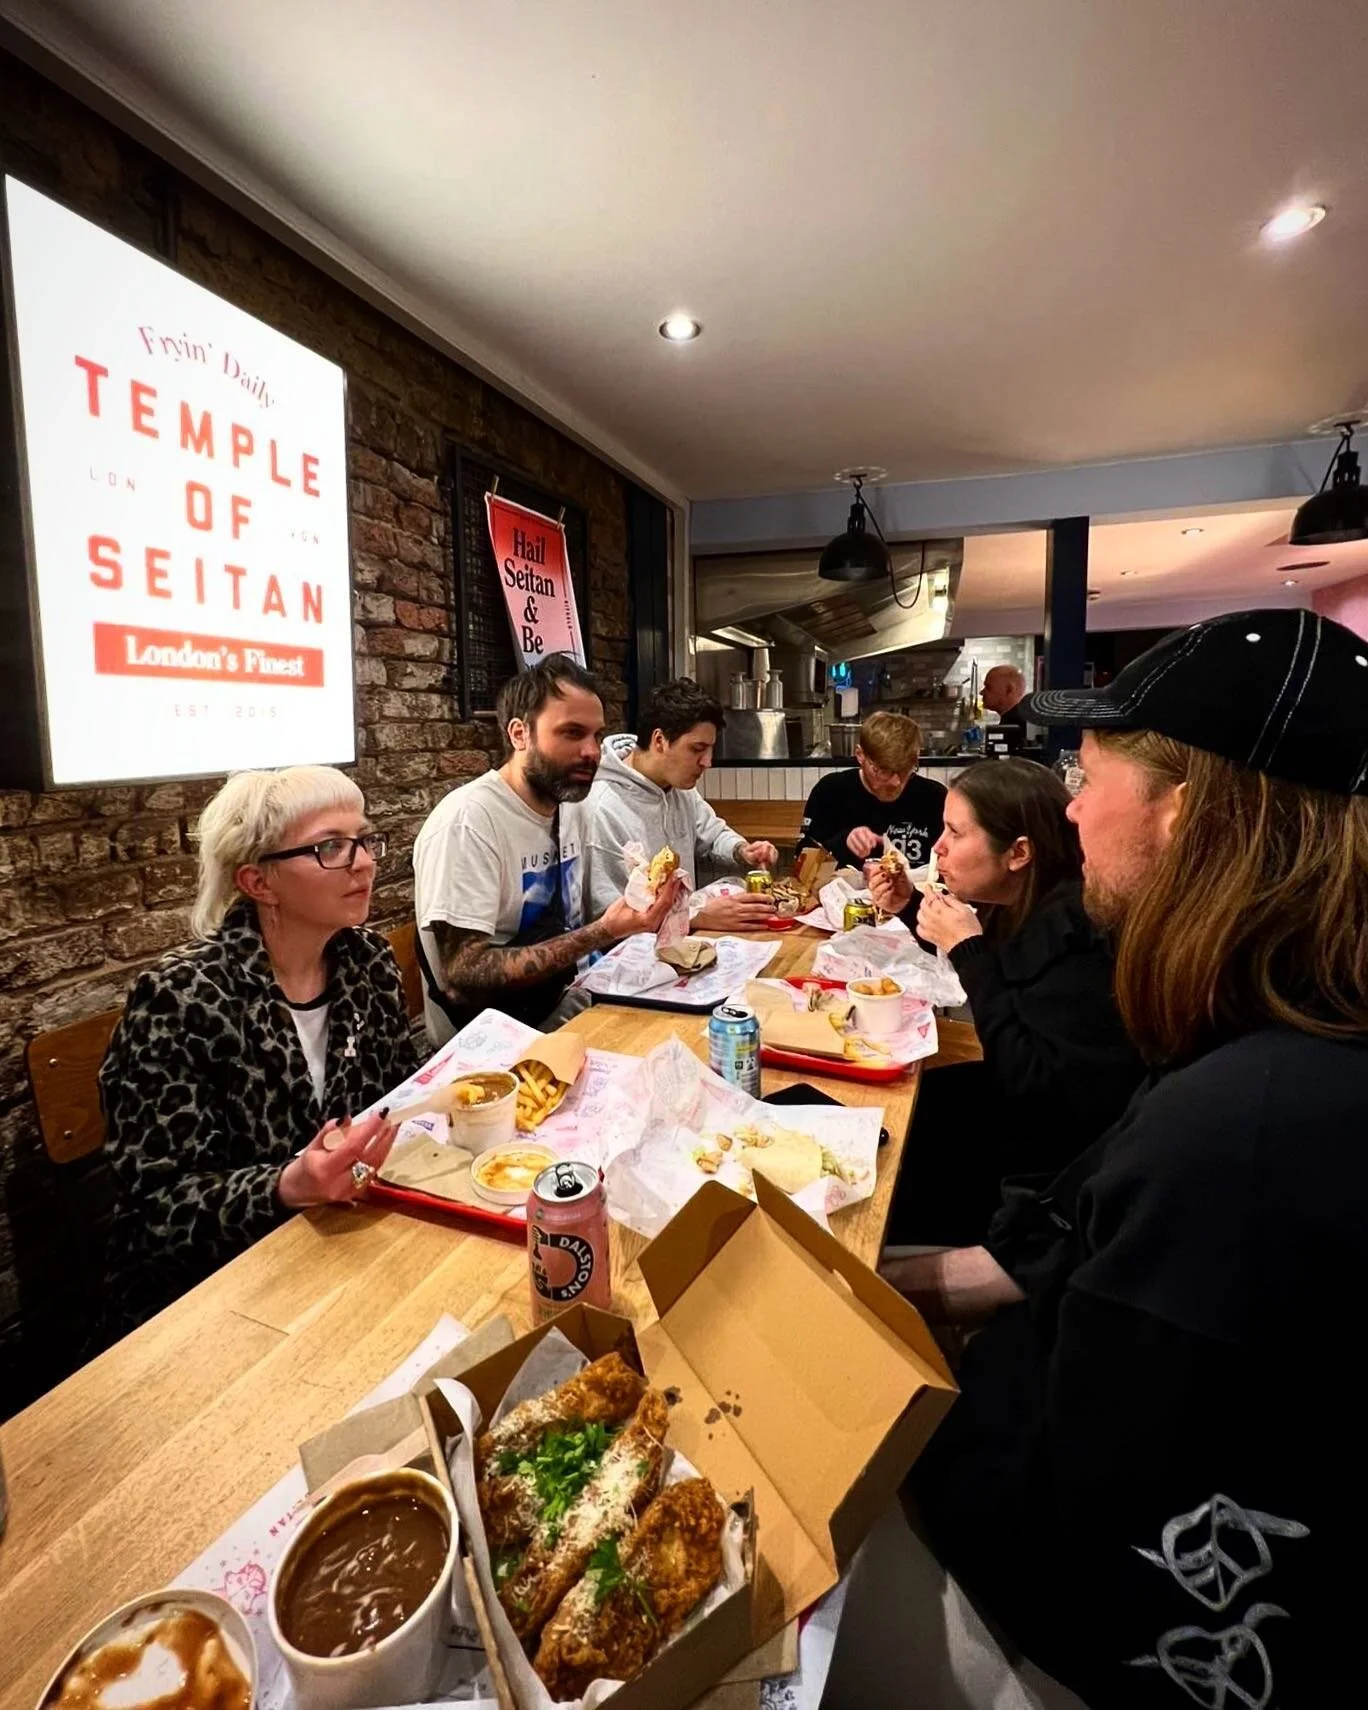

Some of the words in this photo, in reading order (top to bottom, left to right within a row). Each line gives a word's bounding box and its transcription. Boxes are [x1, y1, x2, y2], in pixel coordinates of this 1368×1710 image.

[74, 354, 321, 498] TEMPLE
[90, 464, 136, 492] LON
[185, 479, 253, 541] OF
[513, 527, 546, 566] Hail
[87, 533, 323, 624] SEITAN
[504, 557, 556, 598] Seitan
[523, 595, 540, 624] &
[125, 634, 239, 673] London's
[243, 647, 305, 678] Finest
[522, 625, 545, 654] Be
